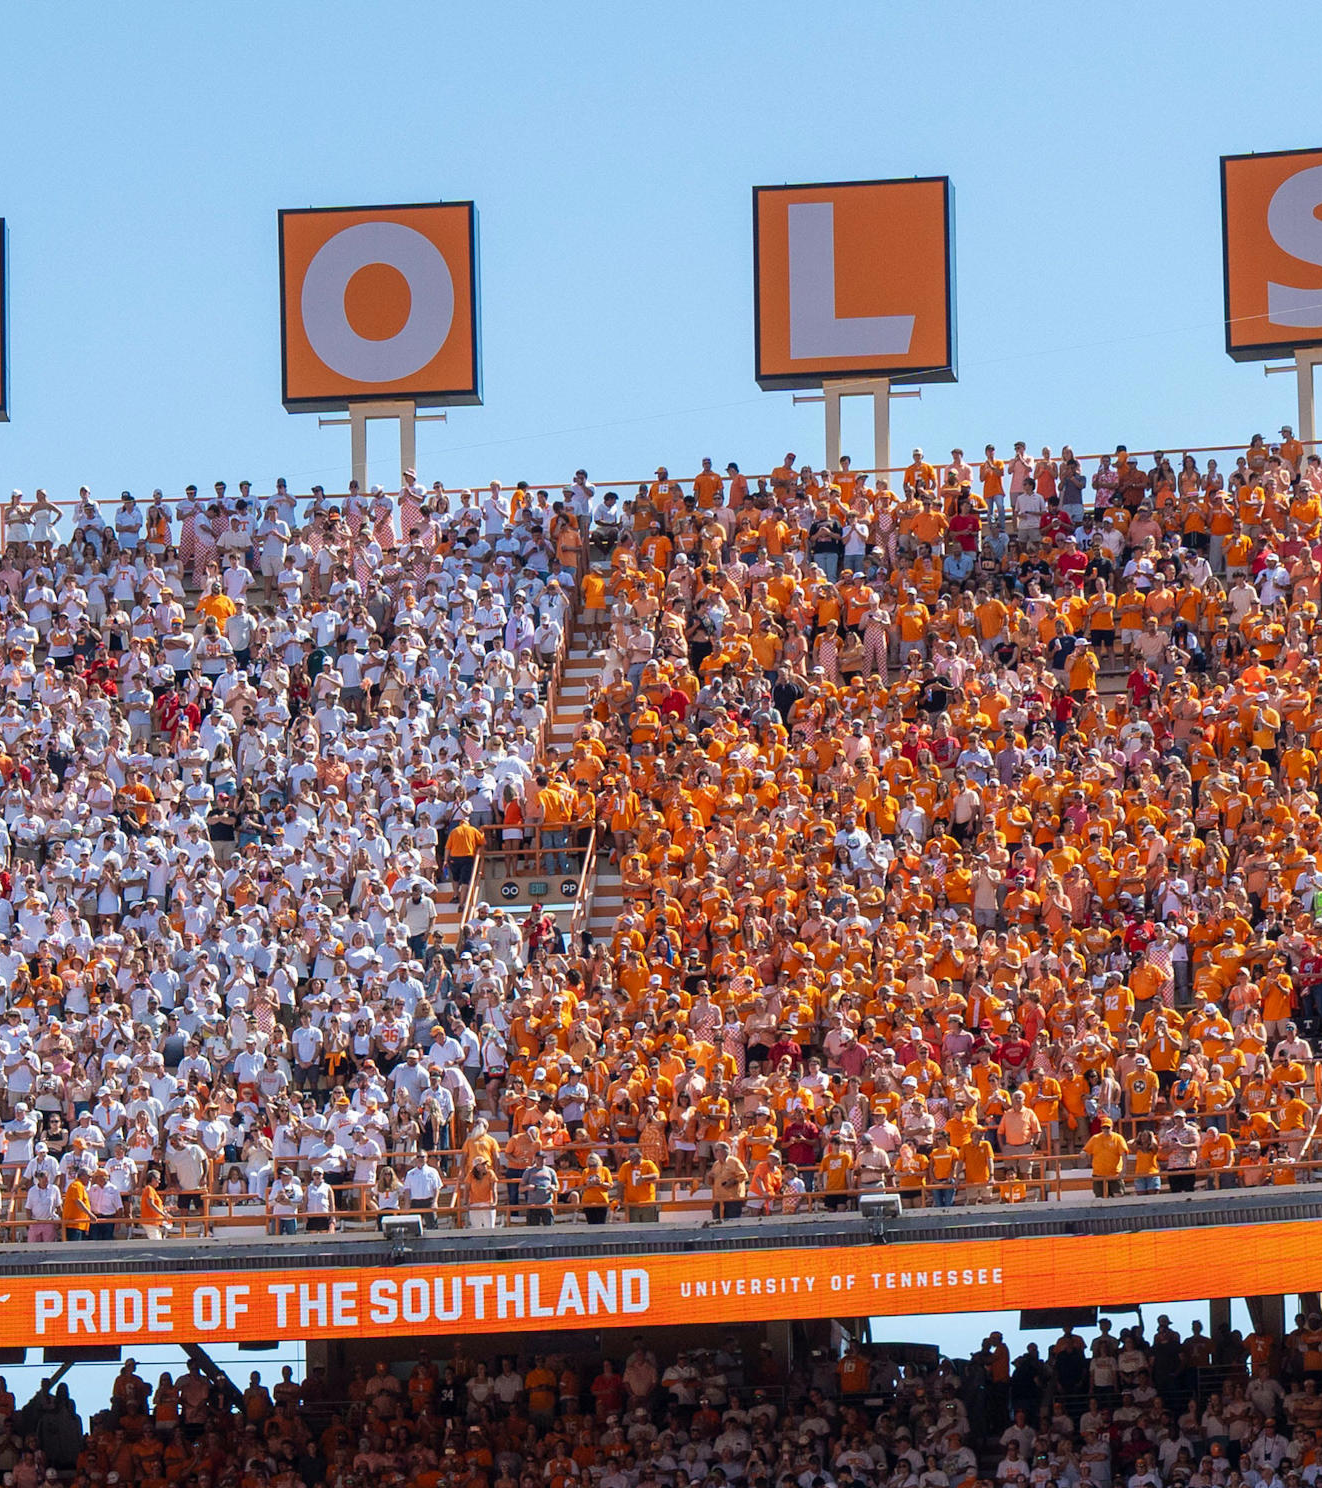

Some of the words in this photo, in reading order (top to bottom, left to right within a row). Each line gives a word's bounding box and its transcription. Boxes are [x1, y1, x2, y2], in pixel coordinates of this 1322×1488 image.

[301, 221, 455, 383] O
[788, 202, 916, 359] L
[1061, 602, 1071, 614] 6
[501, 887, 519, 896] OO
[561, 884, 577, 893] PP
[1303, 1020, 1313, 1029] T
[680, 1277, 815, 1298] UNIVERSITY
[830, 1274, 855, 1291] OF
[871, 1267, 1003, 1289] TENNESSEE
[34, 1287, 174, 1335] PRIDE
[192, 1284, 250, 1332] OF
[269, 1280, 358, 1328] THE
[369, 1268, 650, 1324] SOUTHLAND
[442, 1389, 453, 1400] 34
